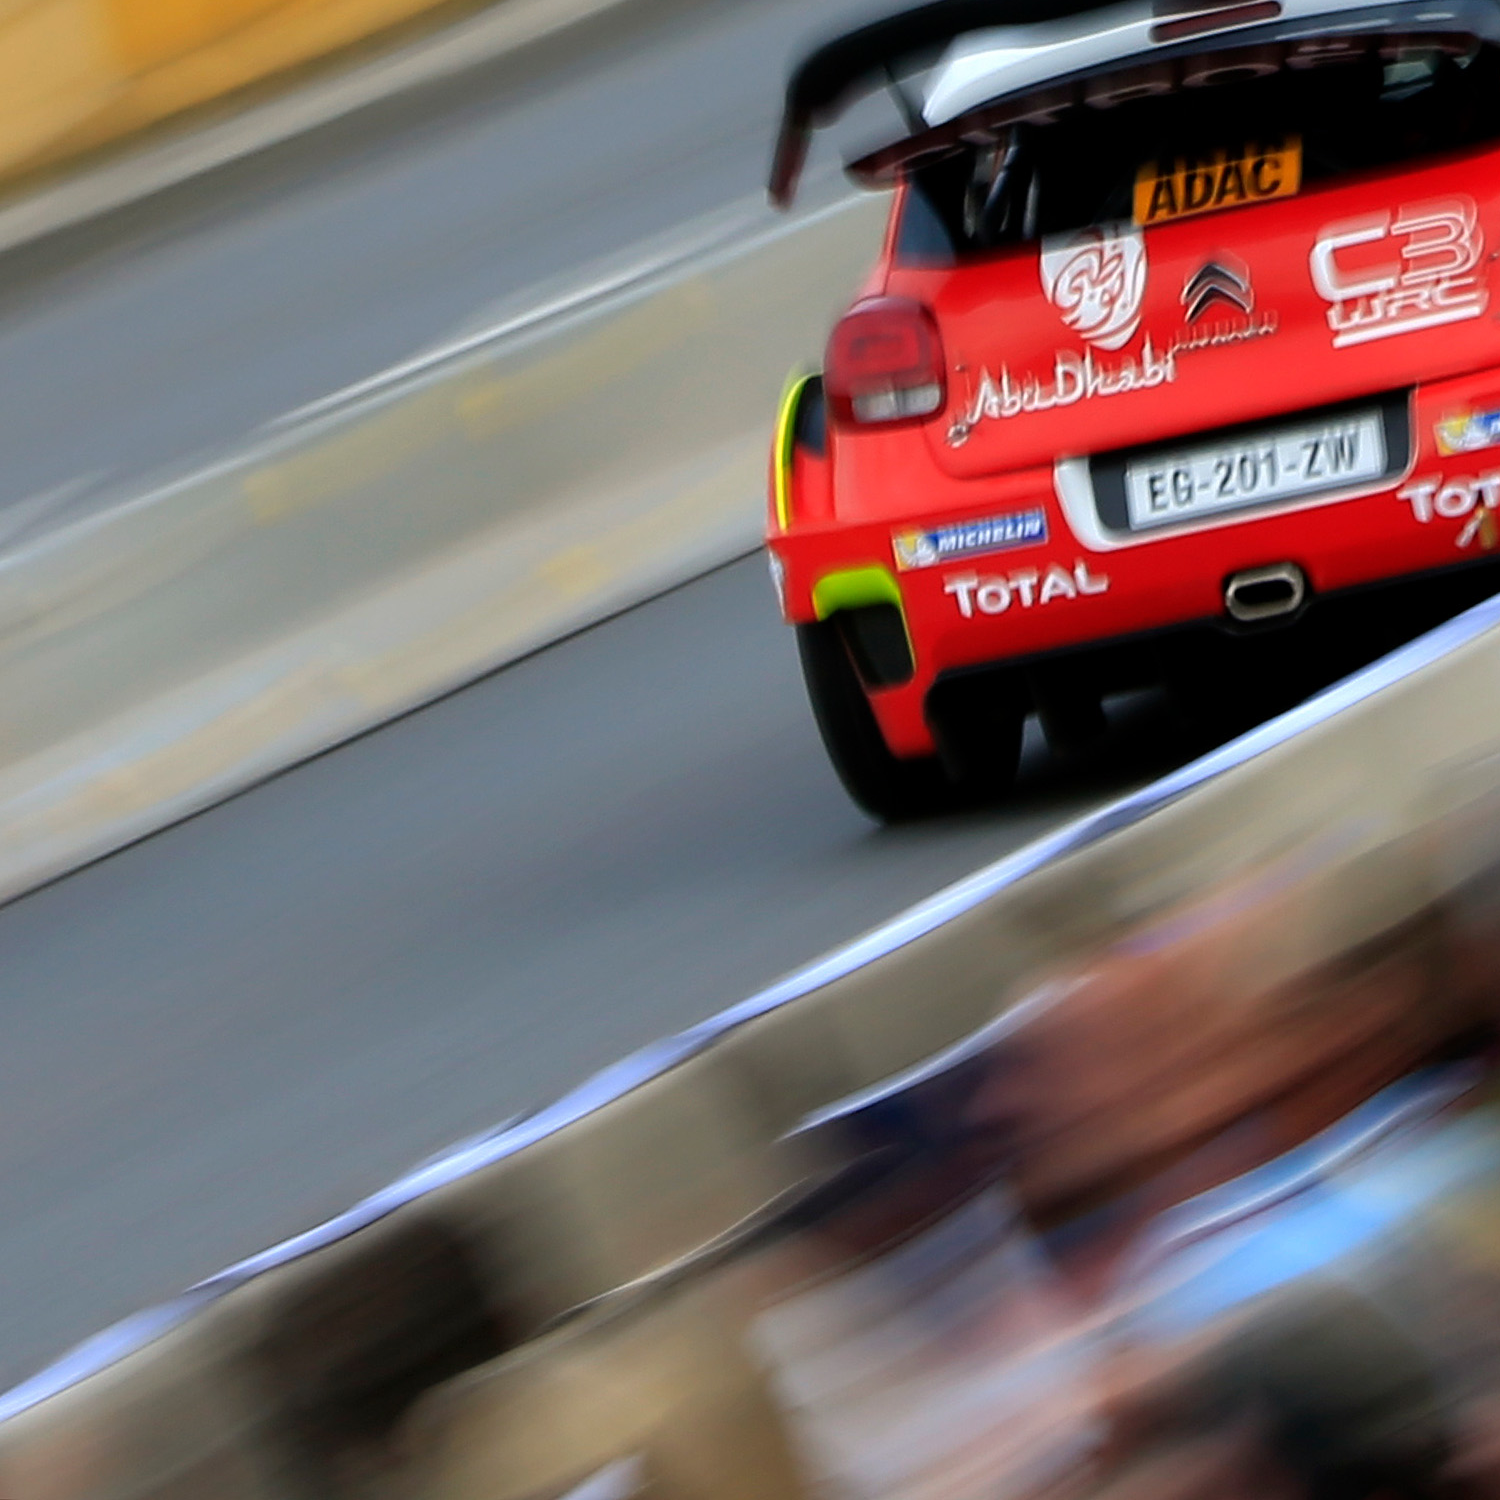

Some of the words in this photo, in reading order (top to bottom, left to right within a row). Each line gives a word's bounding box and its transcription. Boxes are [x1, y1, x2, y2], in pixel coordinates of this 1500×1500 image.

[1145, 156, 1283, 221] ADAC
[1309, 200, 1484, 303] C3
[1326, 274, 1482, 332] WRC
[1148, 430, 1359, 513] EG-201-ZW
[937, 516, 1043, 553] MICHELIN
[943, 560, 1110, 619] TOTAL
